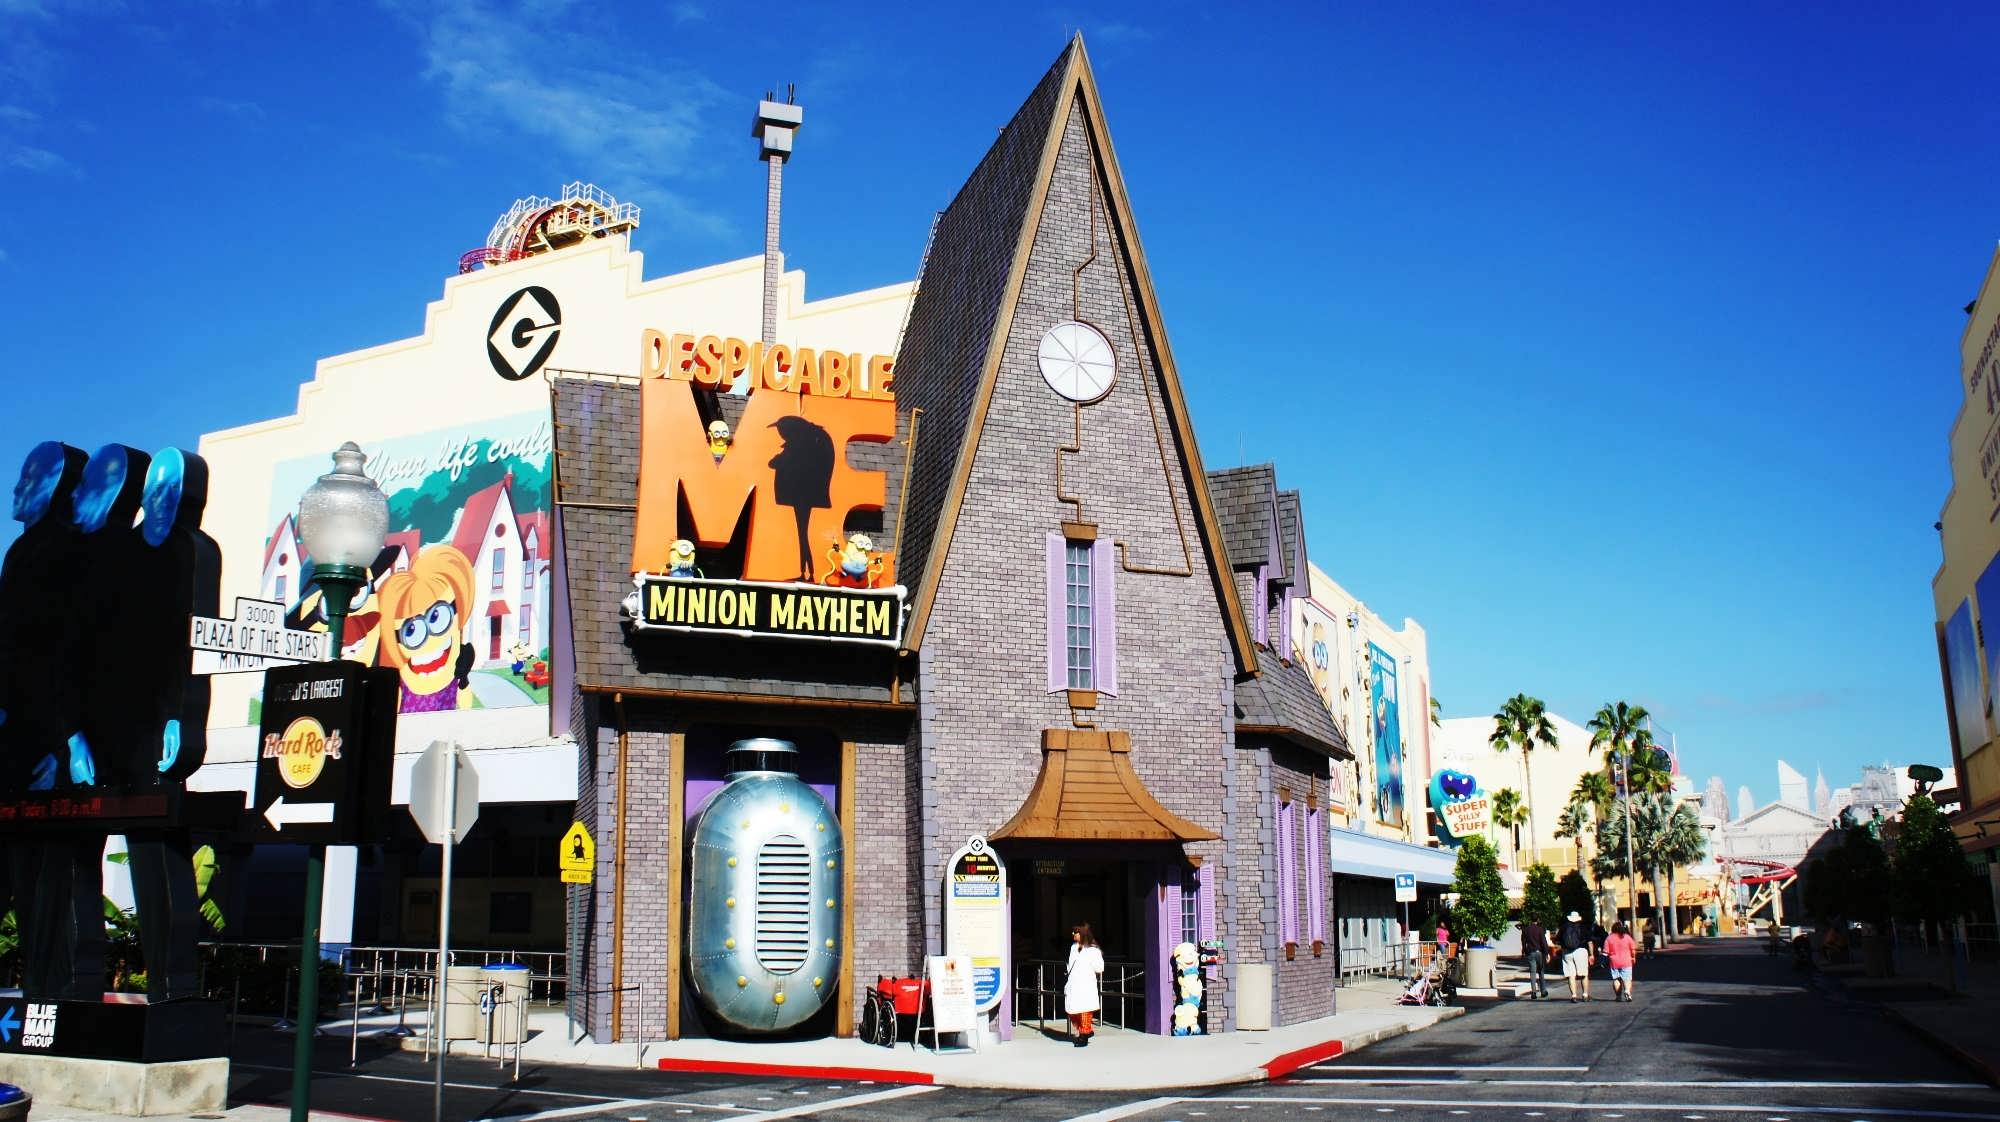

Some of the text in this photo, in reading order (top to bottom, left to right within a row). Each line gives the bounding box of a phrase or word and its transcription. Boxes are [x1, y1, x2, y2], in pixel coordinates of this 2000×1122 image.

[641, 328, 895, 400] DESPICABLE
[436, 432, 479, 482] life
[631, 378, 896, 588] ME
[247, 606, 275, 624] 3000
[649, 585, 890, 636] MINION MAYHEM
[195, 620, 318, 658] PLAZA OF THE STARS
[275, 679, 344, 701] LD'S LARGEST
[263, 729, 343, 760] Hard Rock
[292, 764, 311, 774] CAFE
[1446, 799, 1488, 816] SUPER
[1458, 811, 1480, 823] SILLY
[1453, 821, 1488, 833] STUFF
[26, 1003, 58, 1019] BLUE
[24, 1018, 57, 1036] MAN
[22, 1035, 54, 1048] GROUP
